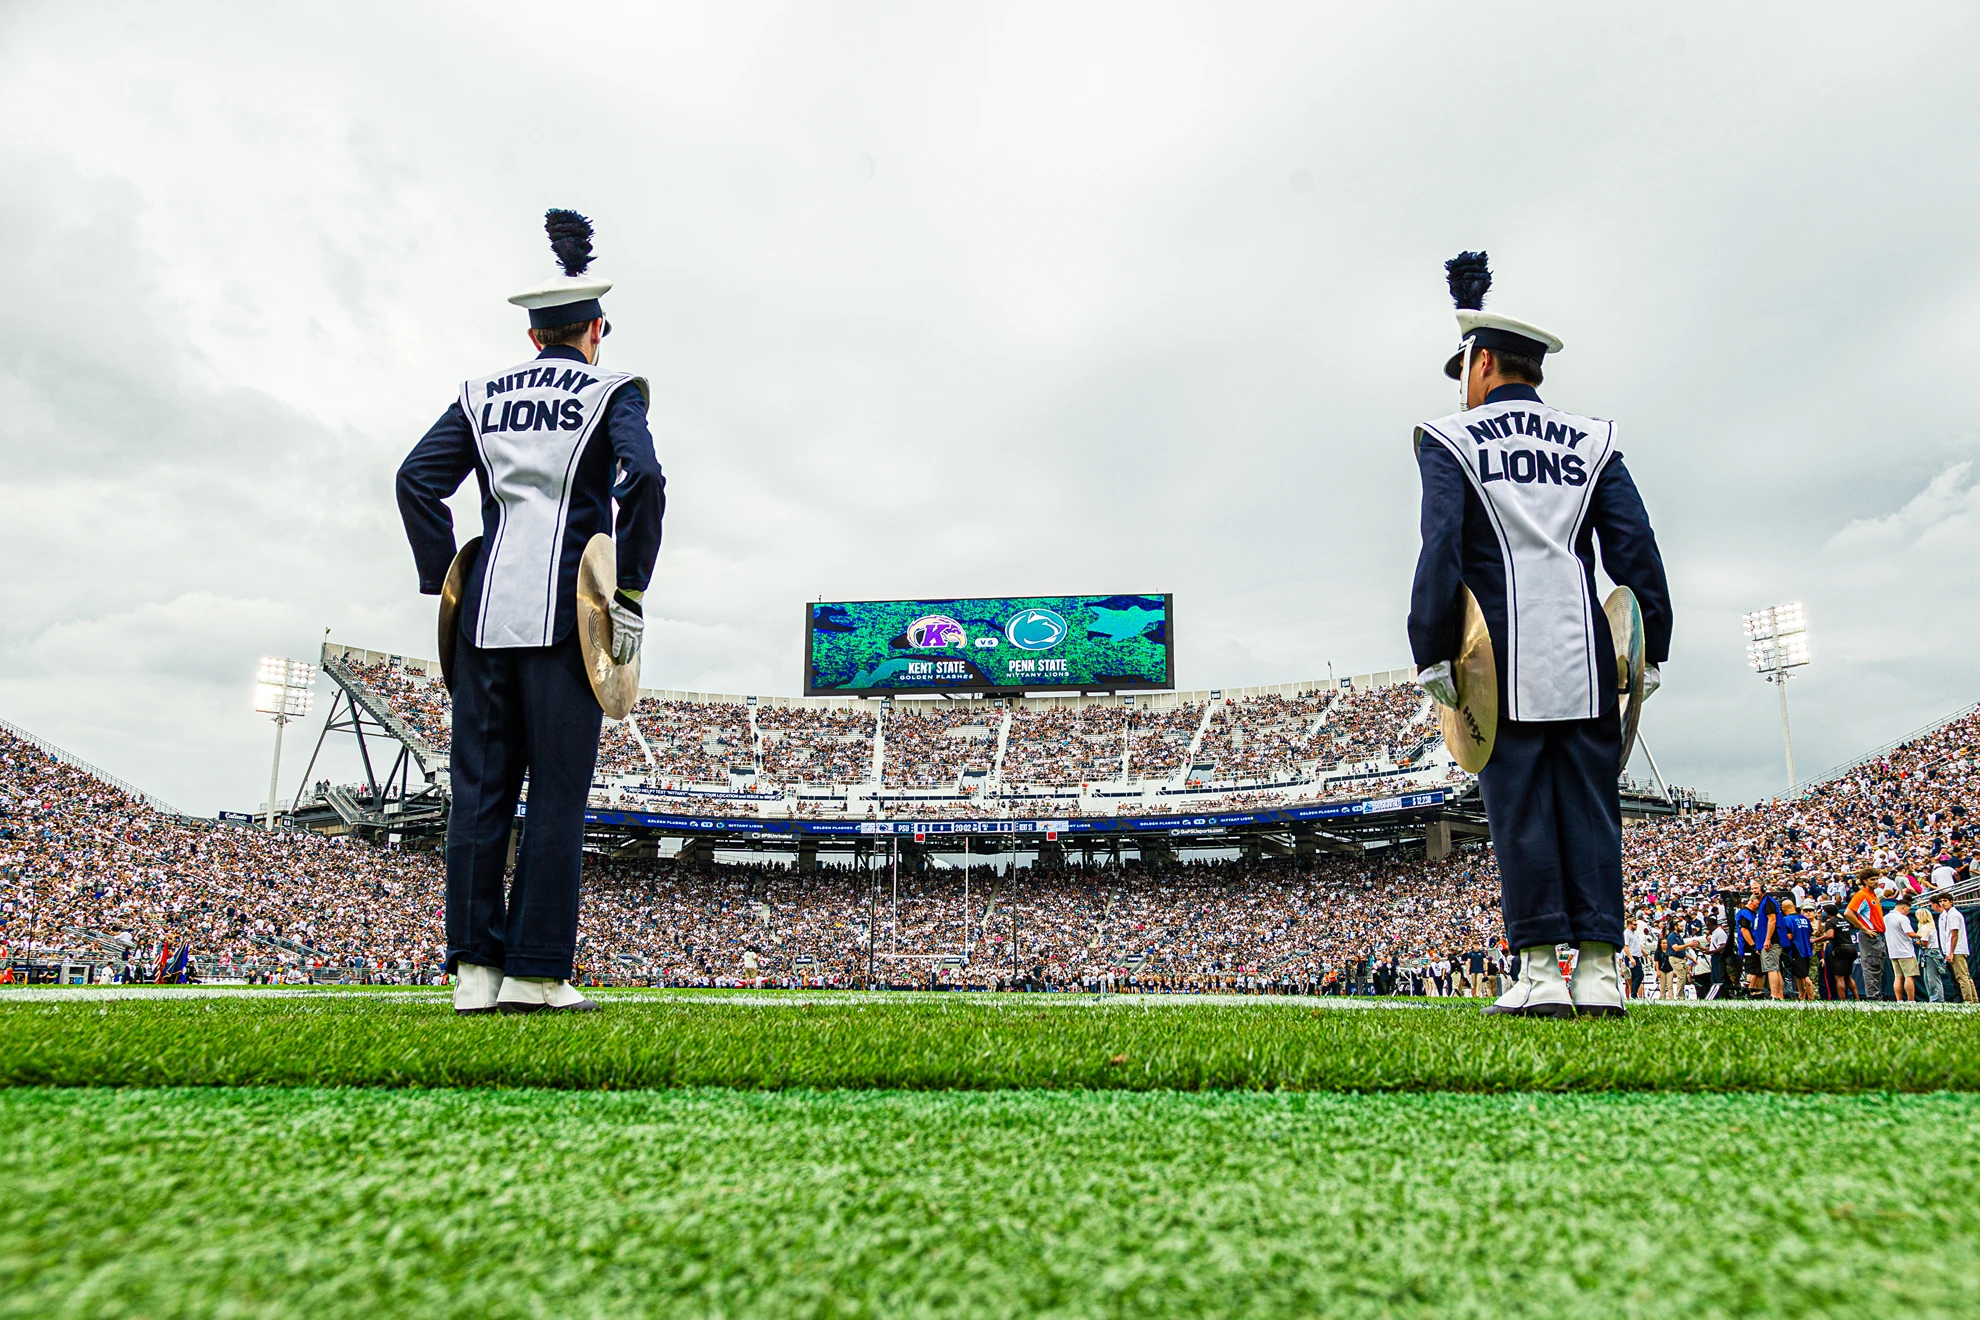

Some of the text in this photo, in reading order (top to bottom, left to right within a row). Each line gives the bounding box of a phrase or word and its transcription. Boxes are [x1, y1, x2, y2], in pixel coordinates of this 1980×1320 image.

[486, 367, 600, 399] NITTANY
[481, 398, 585, 435] LIONS
[1465, 411, 1589, 450] NITTANY
[1478, 449, 1588, 487] LIONS
[908, 661, 966, 674] KENT STATE
[1009, 659, 1067, 672] PENN STATE
[1463, 705, 1487, 747] HHX
[955, 824, 972, 832] 20:02
